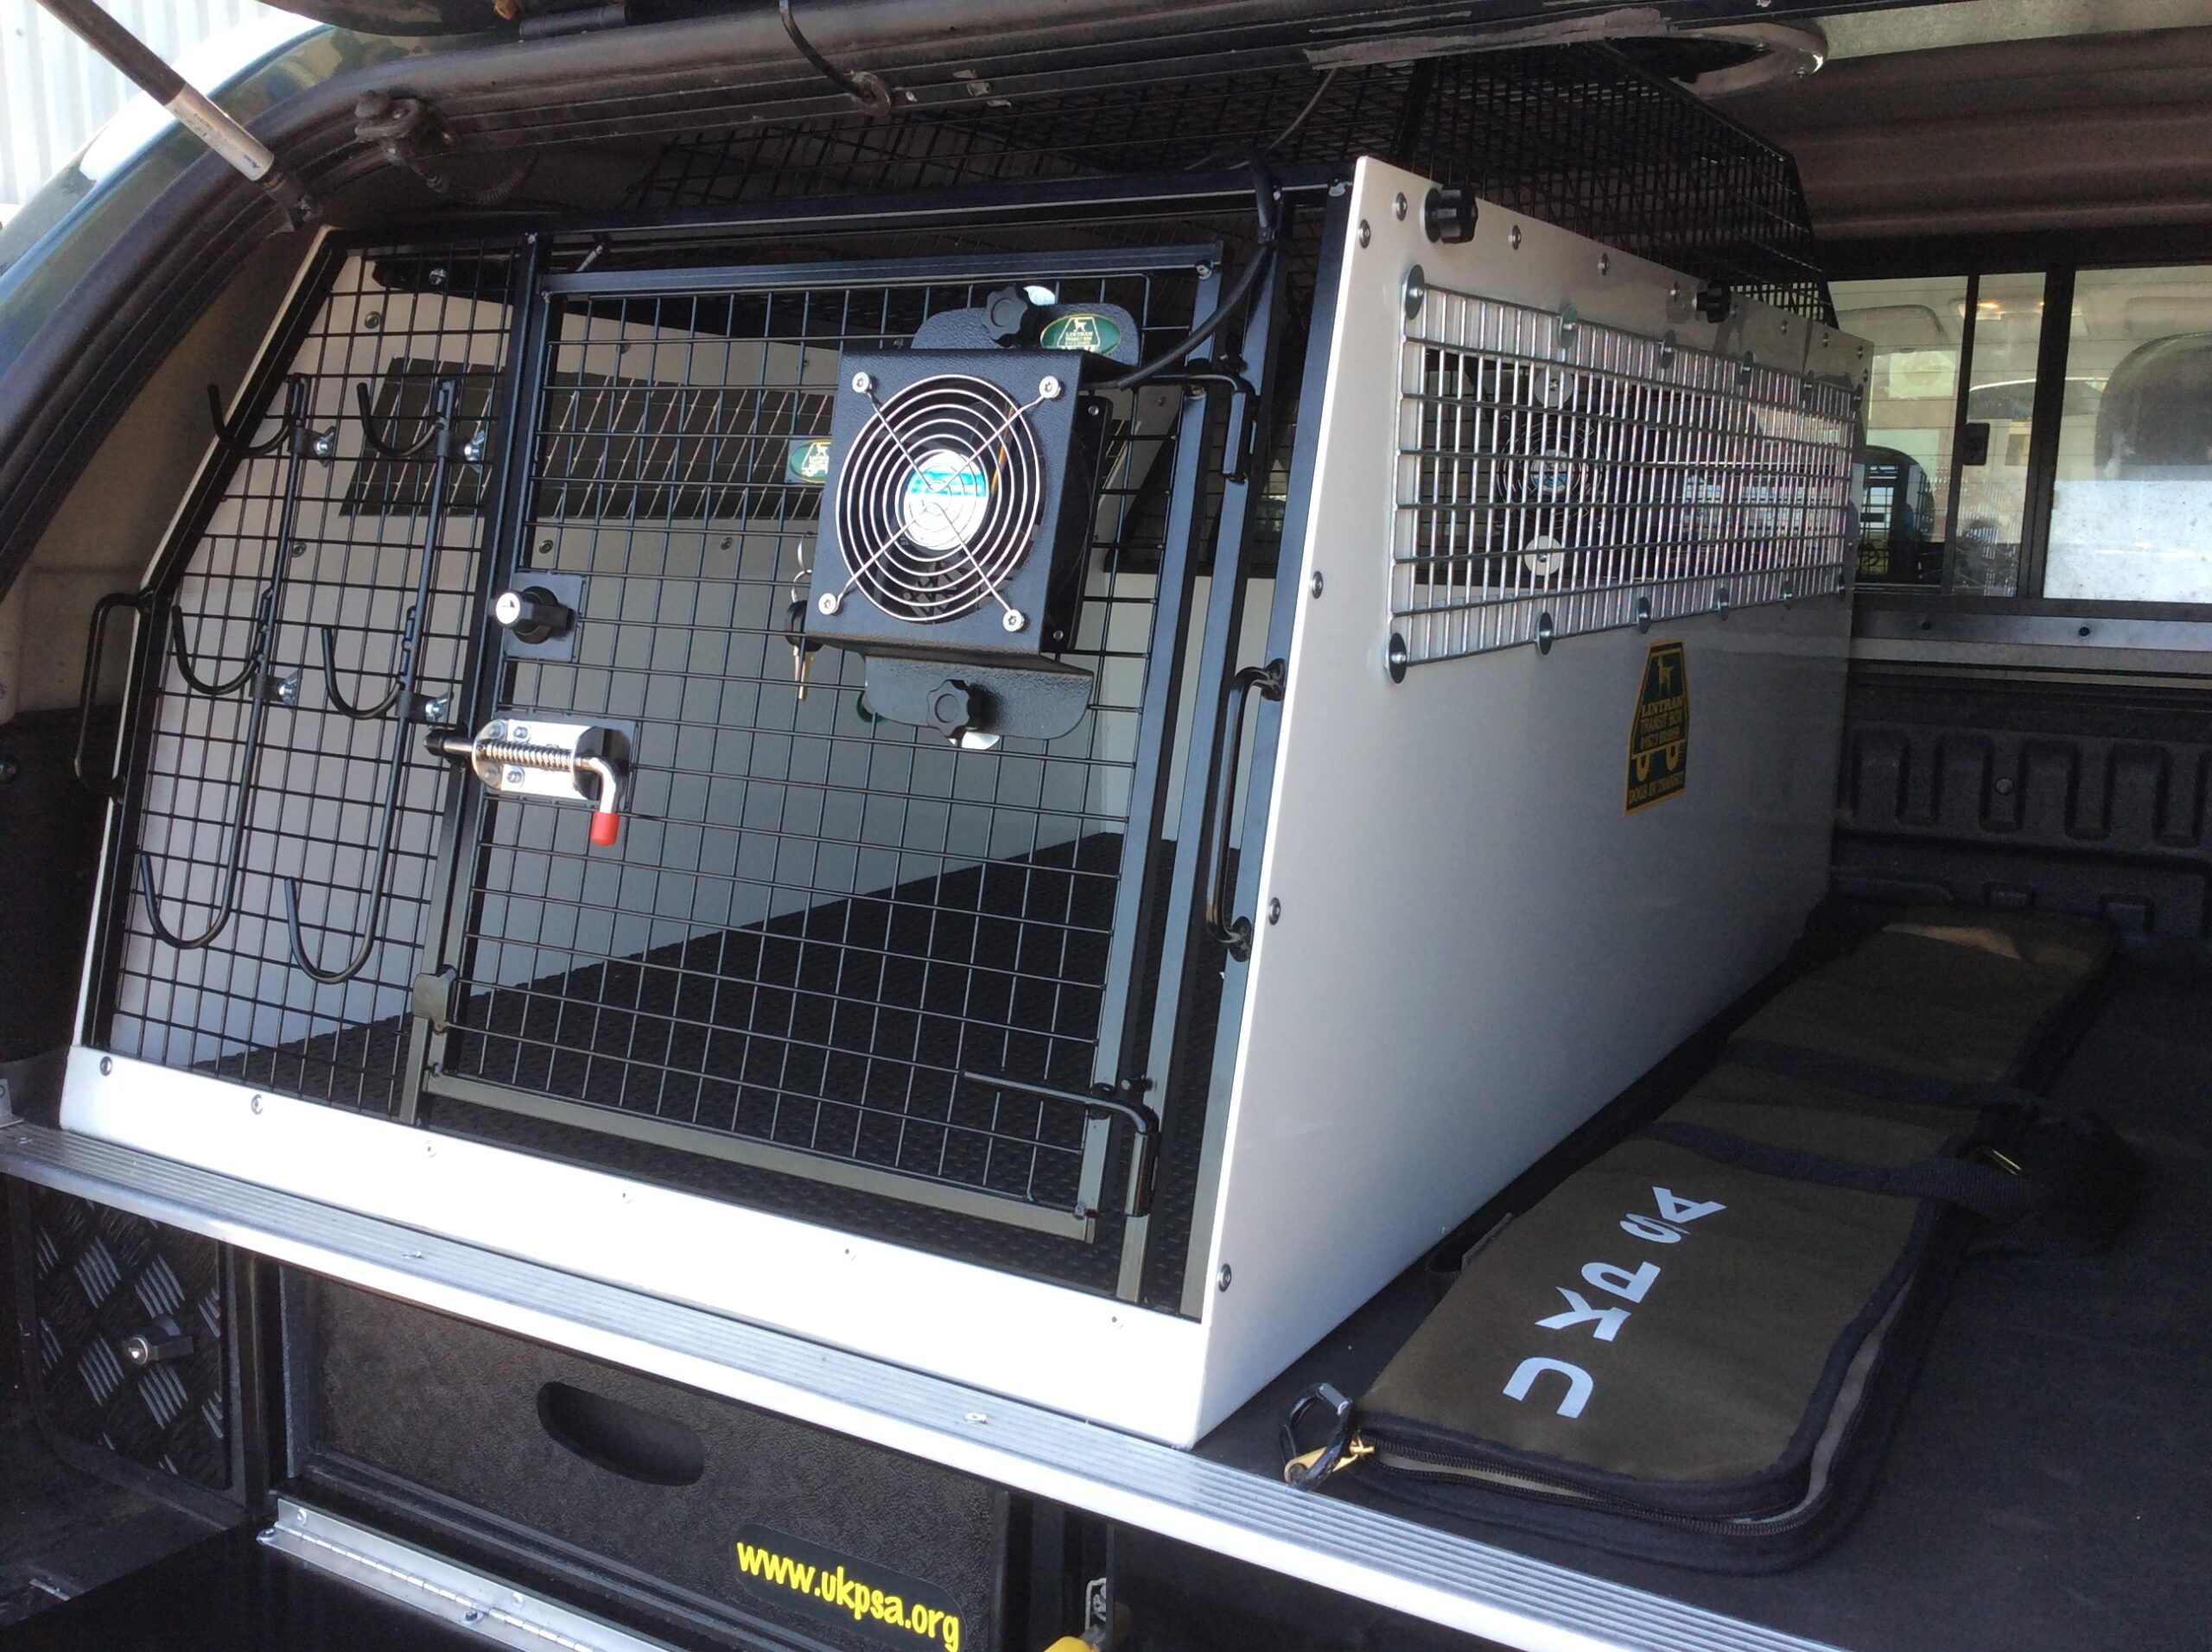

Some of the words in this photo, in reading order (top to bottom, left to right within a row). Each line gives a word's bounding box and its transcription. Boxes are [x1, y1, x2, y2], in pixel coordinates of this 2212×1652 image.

[1628, 784, 1648, 804] DOGS
[1649, 780, 1657, 797] IN
[1503, 1186, 1727, 1419] UKPSA
[736, 1541, 959, 1652] www.ukpsa.org
